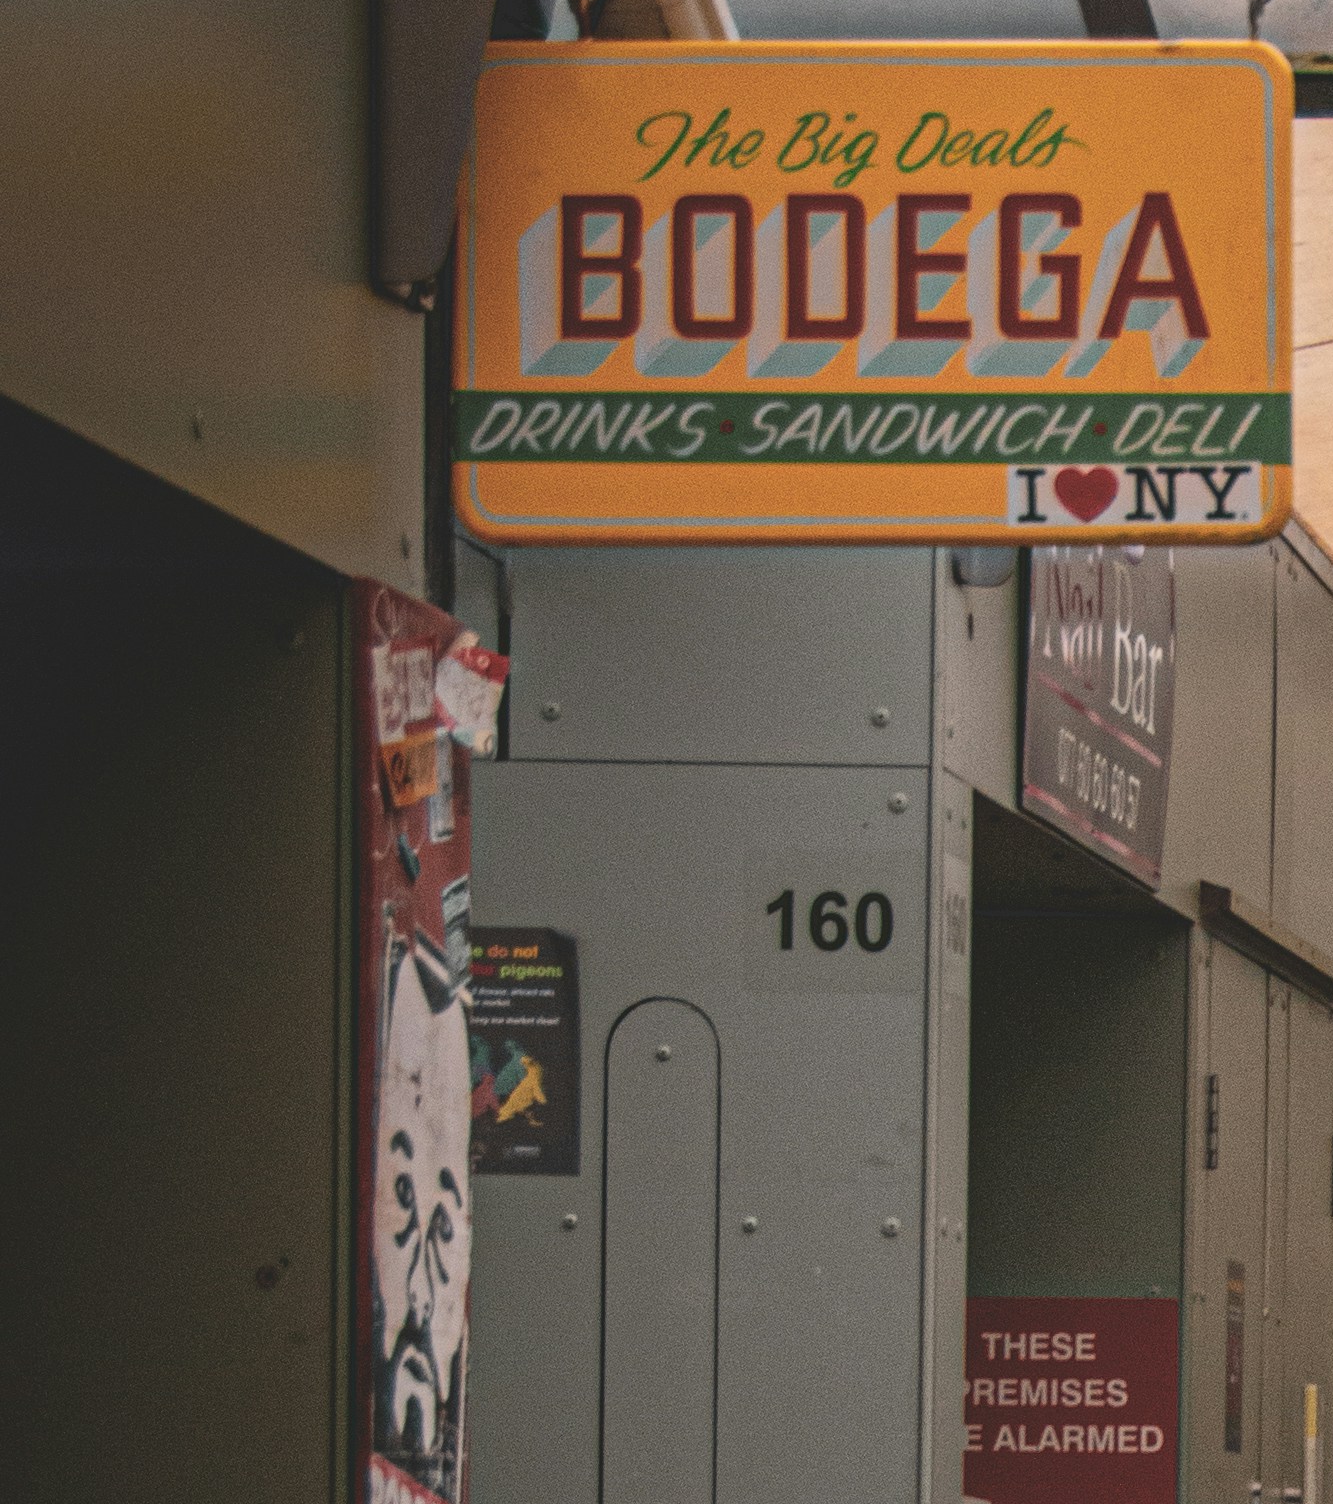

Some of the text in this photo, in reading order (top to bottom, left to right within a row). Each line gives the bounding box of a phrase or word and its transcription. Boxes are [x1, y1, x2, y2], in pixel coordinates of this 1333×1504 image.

[635, 107, 1092, 188] The Big Deals
[557, 192, 1211, 342] BODEGA
[470, 400, 1262, 457] DRINKS SANDWICH DELI
[1017, 466, 1252, 523] I NY
[765, 890, 894, 952] 160
[487, 945, 508, 959] do
[513, 944, 539, 959] not
[500, 965, 563, 981] pigeons
[981, 1332, 1096, 1361] THESE
[993, 1425, 1164, 1454] ALARMED
